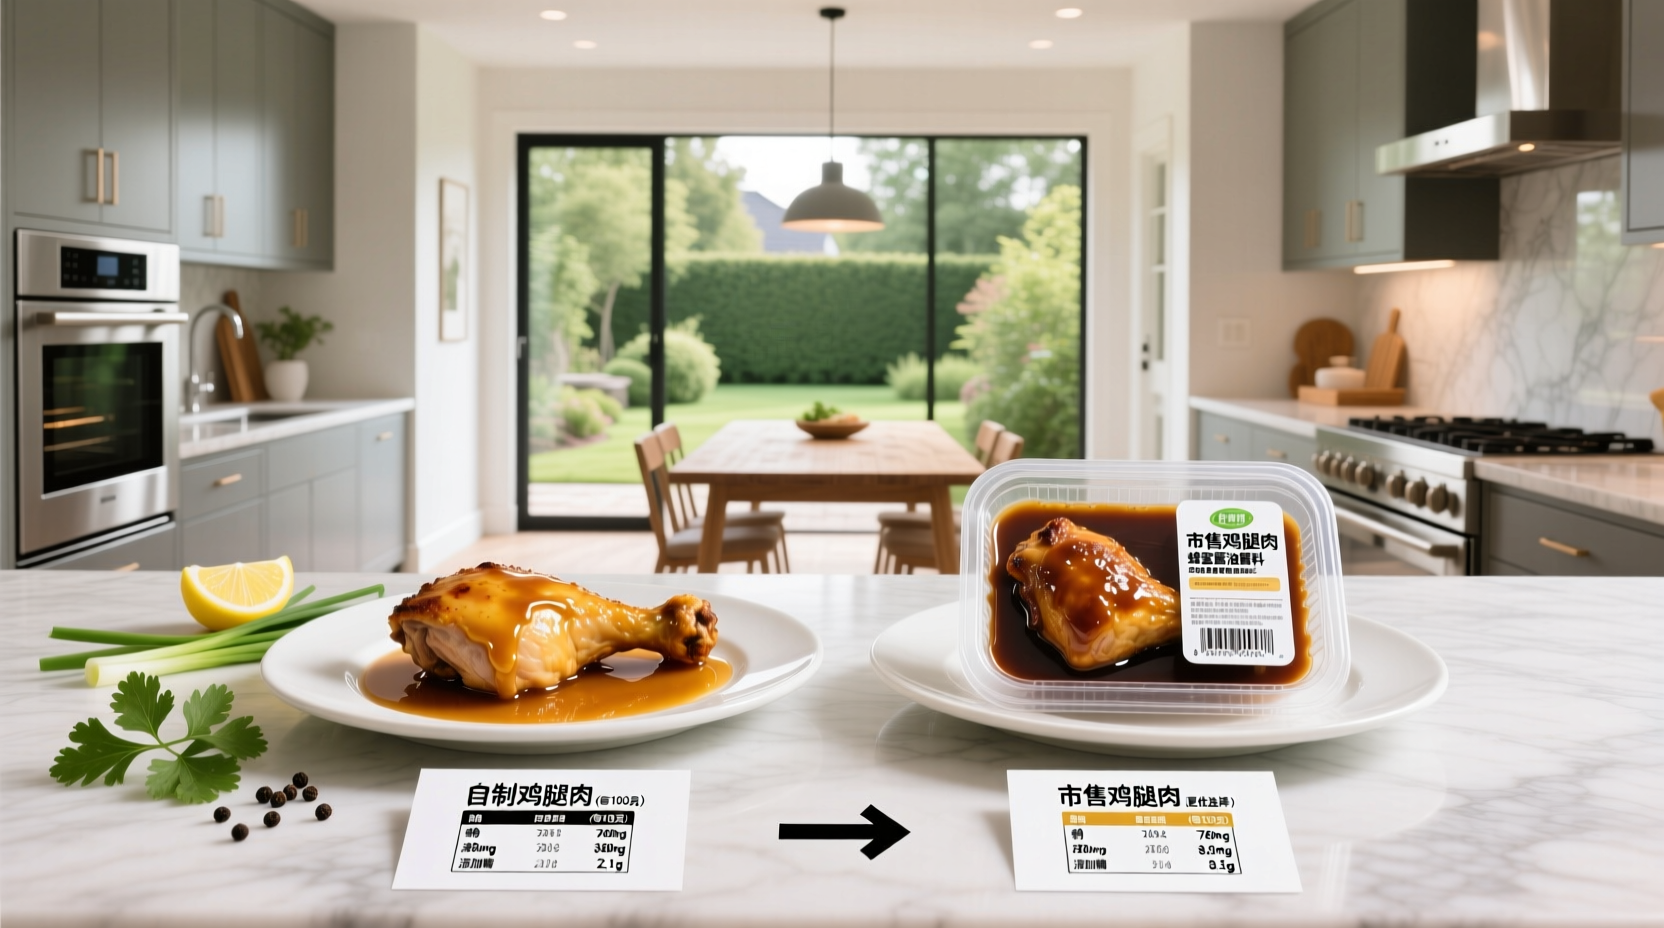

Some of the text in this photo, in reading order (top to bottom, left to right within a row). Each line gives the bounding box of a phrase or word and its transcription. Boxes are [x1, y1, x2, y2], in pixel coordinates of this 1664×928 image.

[1186, 532, 1278, 550] 市售鸡腿肉
[467, 782, 593, 807] 自制鸡腿肉
[1057, 783, 1181, 808] 市售鸡腿肉
